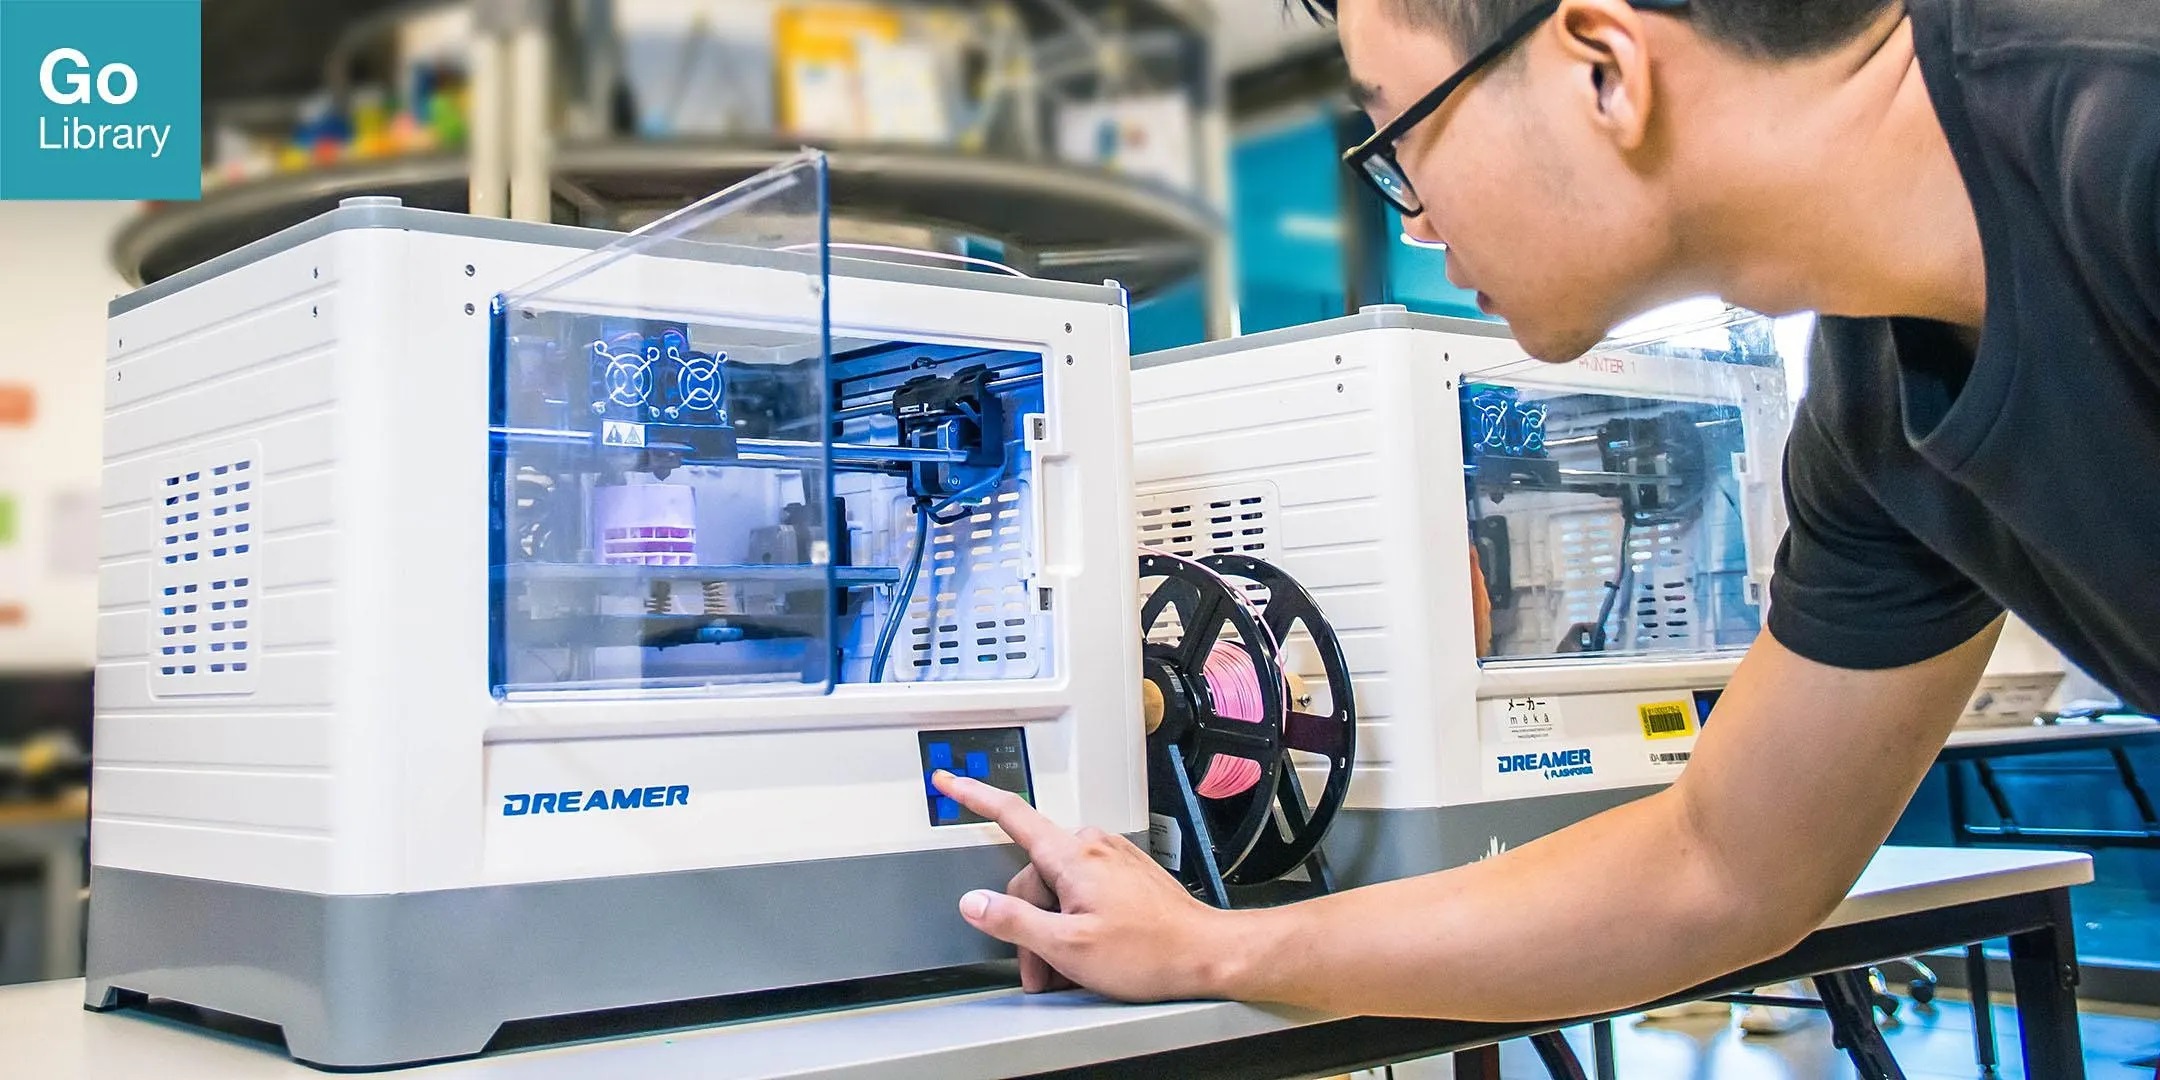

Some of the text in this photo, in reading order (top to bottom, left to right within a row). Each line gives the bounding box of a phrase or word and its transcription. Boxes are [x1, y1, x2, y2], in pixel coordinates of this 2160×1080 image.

[1508, 697, 1546, 711] メーカー
[1497, 748, 1591, 773] DREAMER
[503, 784, 690, 816] DREAMER
